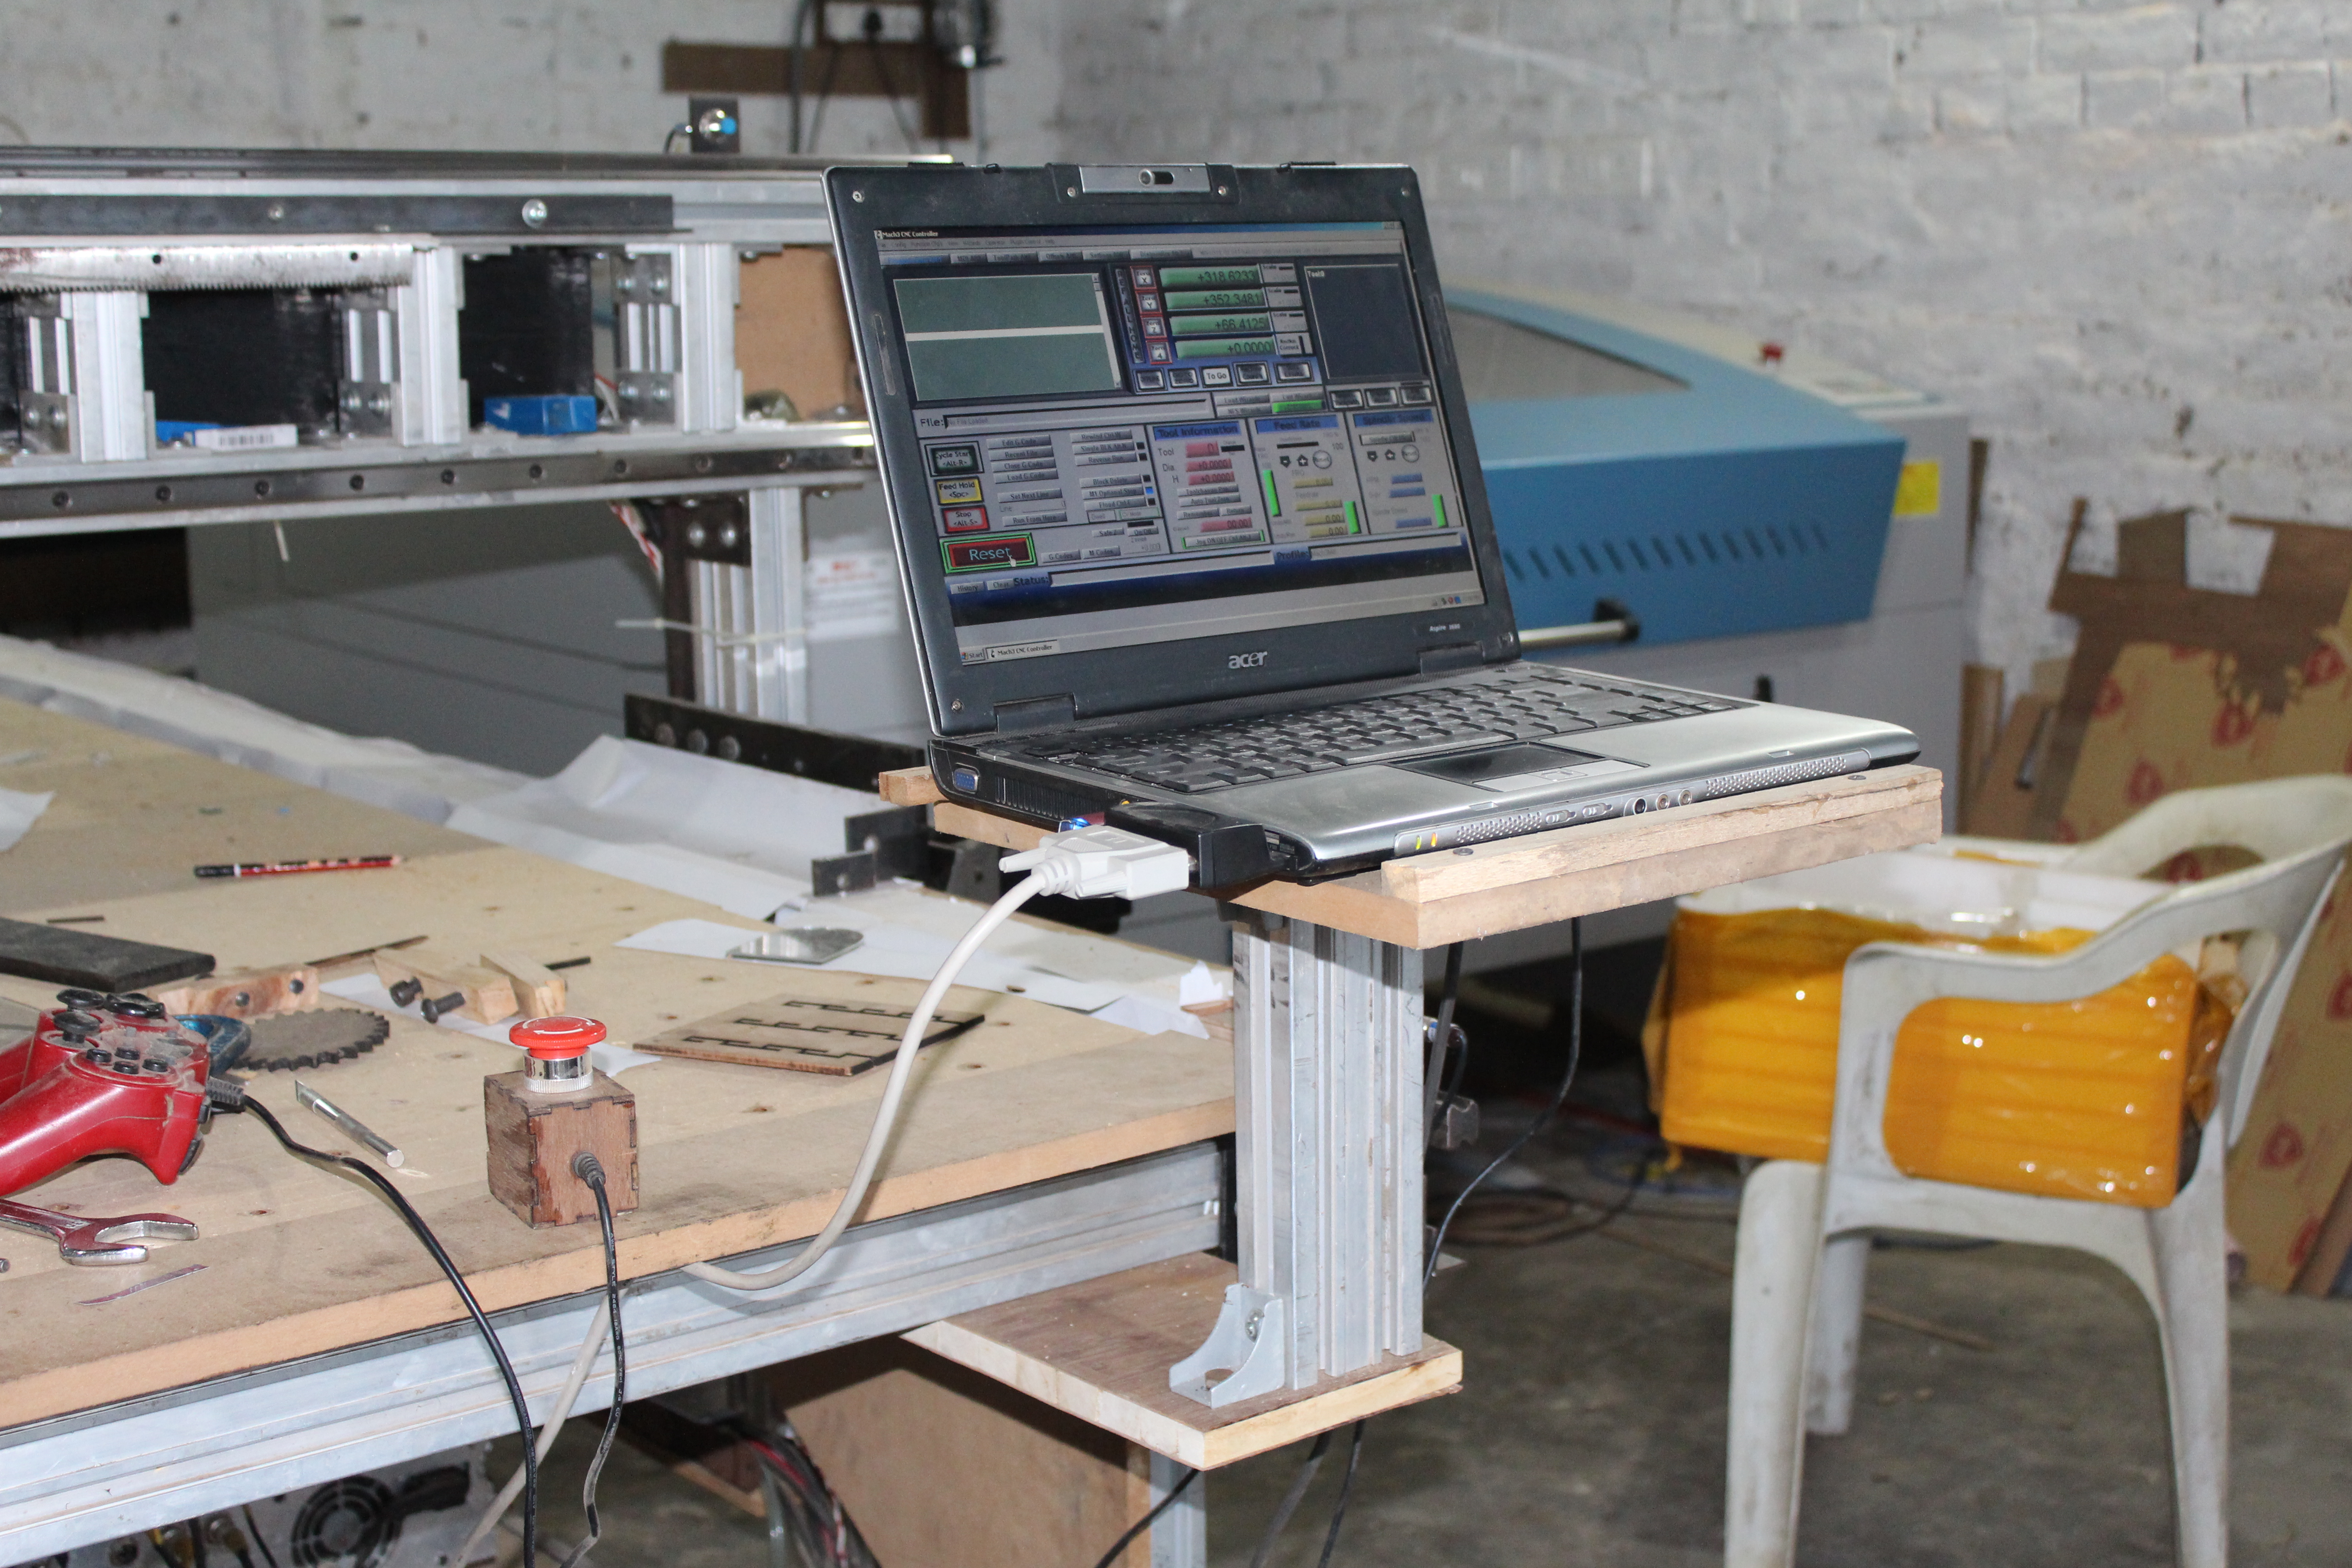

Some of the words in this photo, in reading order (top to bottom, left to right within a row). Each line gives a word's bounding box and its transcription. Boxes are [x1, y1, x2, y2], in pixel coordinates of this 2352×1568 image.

[1198, 270, 1254, 282] +3186233
[1204, 293, 1260, 305] +3523481
[1215, 317, 1265, 330] +664125
[1227, 341, 1271, 353] +00000
[920, 418, 944, 427] File:
[1158, 429, 1180, 438] Tool
[1181, 426, 1239, 436] Information
[1158, 448, 1174, 456] Tool
[1172, 475, 1179, 483] H
[959, 481, 975, 489] Hold
[949, 490, 969, 499] <Spc>
[969, 547, 1013, 561] Reset
[1014, 576, 1049, 586] Status:
[957, 584, 978, 593] History
[1228, 651, 1268, 669] acer
